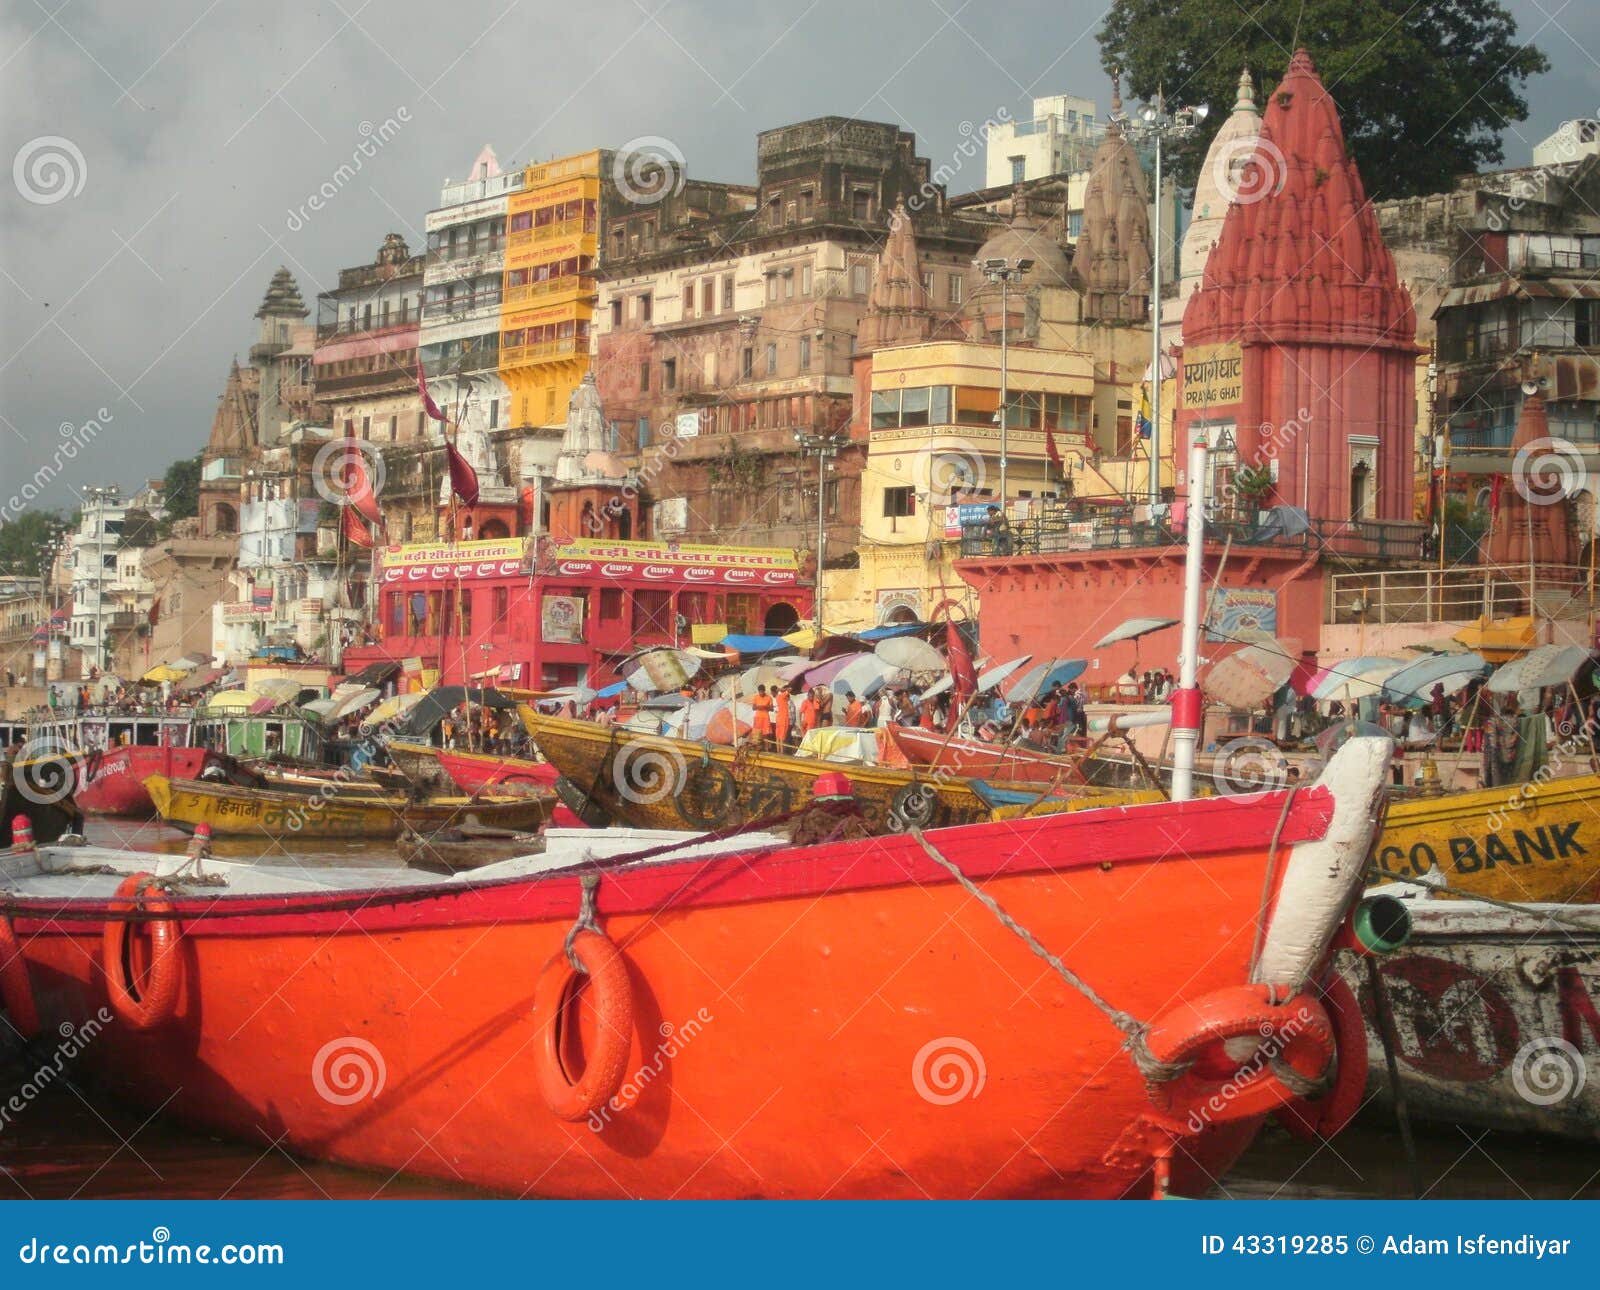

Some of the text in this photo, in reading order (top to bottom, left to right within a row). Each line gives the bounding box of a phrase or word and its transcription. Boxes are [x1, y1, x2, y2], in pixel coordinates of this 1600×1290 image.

[1186, 386, 1241, 404] PRAYAG GHAT
[716, 553, 773, 565] माता
[568, 562, 795, 580] RUPA RUPA RUPA RUPA RUPA RUPA
[1448, 821, 1588, 875] BANK
